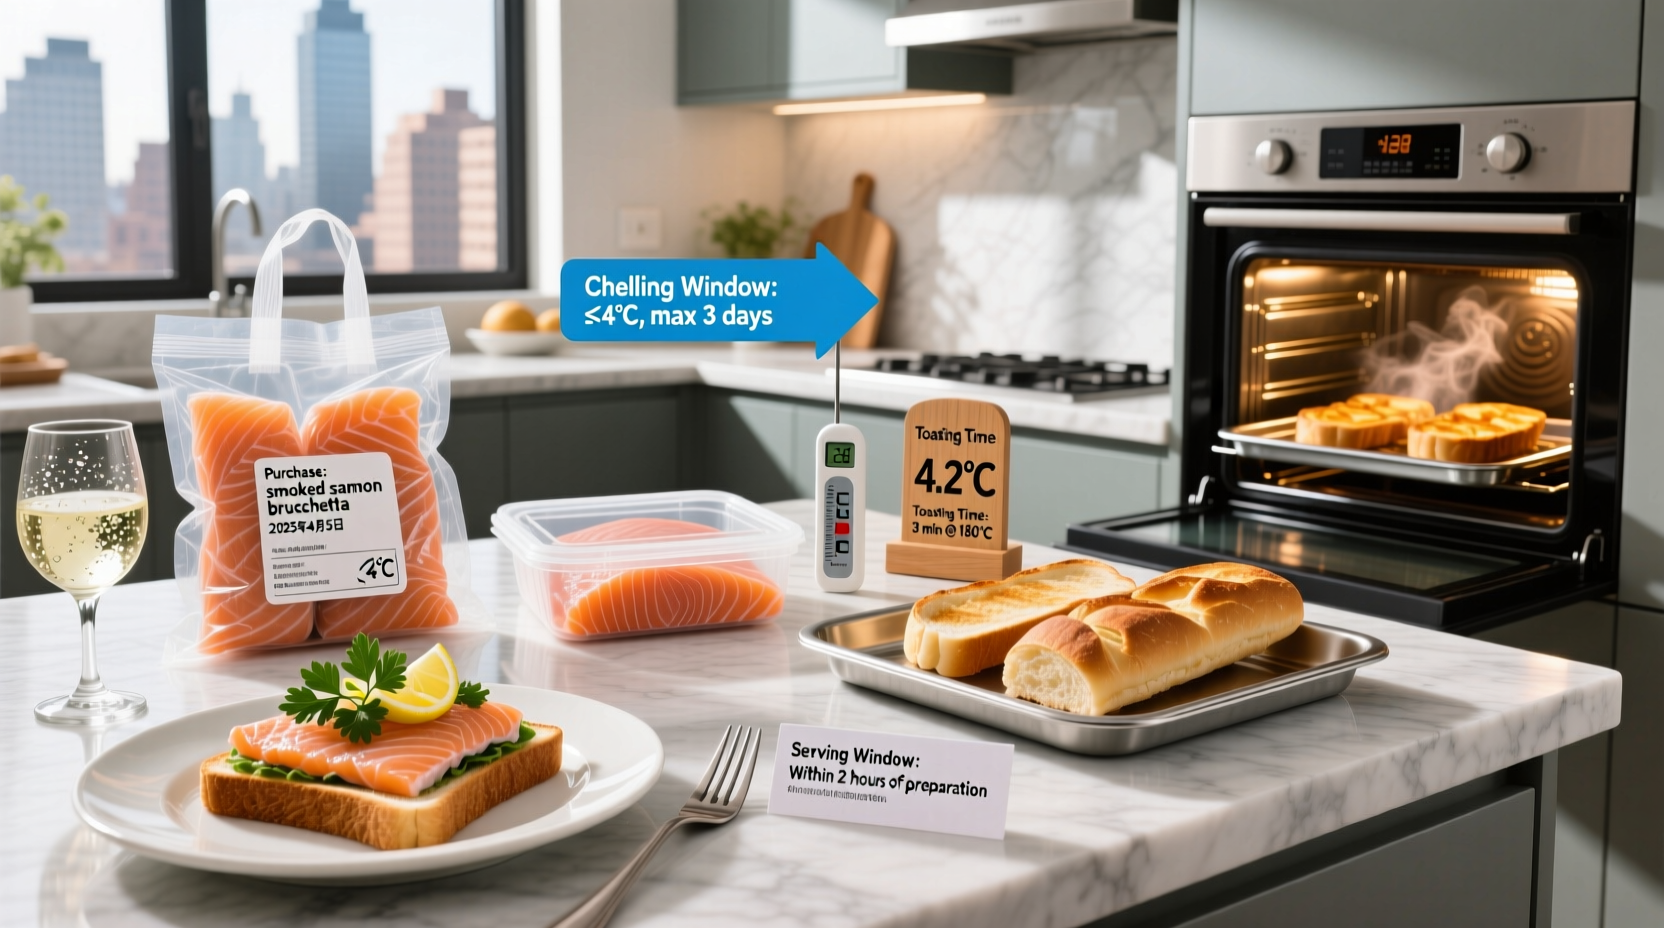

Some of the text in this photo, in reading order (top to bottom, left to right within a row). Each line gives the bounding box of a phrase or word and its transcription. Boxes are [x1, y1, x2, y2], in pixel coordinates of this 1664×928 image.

[264, 466, 327, 480] Purchase:
[914, 458, 996, 498] 4.2°C
[266, 480, 325, 499] smoked
[912, 522, 920, 533] 3
[922, 523, 943, 535] min
[791, 741, 920, 768] Serving Window:
[789, 765, 834, 783] Within
[837, 769, 847, 784] 2
[850, 769, 886, 788] hours
[889, 774, 905, 789] of
[904, 778, 987, 797] preparation
